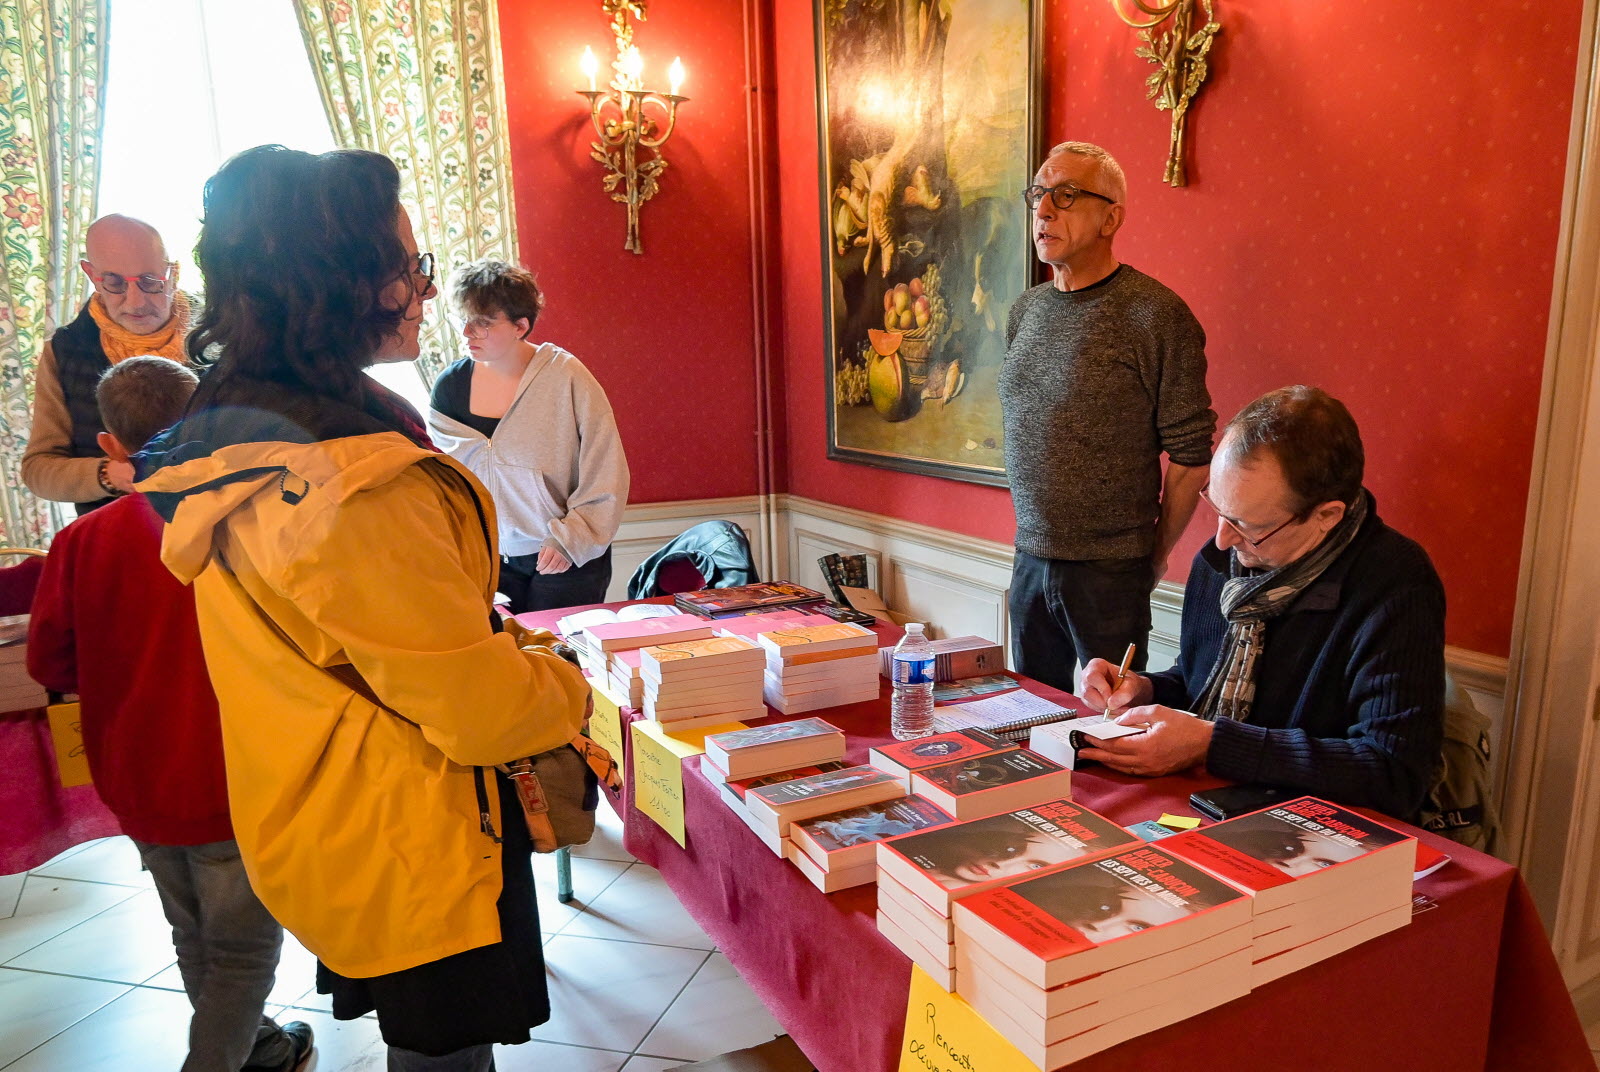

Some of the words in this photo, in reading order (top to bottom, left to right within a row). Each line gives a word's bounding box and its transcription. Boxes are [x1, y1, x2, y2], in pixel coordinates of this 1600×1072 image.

[1297, 800, 1338, 816] OLIVIER
[1015, 810, 1033, 818] LES
[1025, 815, 1047, 825] SEPT
[1039, 822, 1060, 832] VIES
[1269, 808, 1289, 816] LES
[1284, 813, 1308, 823] SEPT
[1302, 820, 1325, 831] VIES
[1132, 849, 1174, 868] OLIVIER
[1099, 858, 1120, 868] LES
[1112, 865, 1138, 877] SEPT
[1129, 873, 1153, 886] VIES
[1145, 883, 1164, 893] DU
[926, 1002, 975, 1072] Rencont
